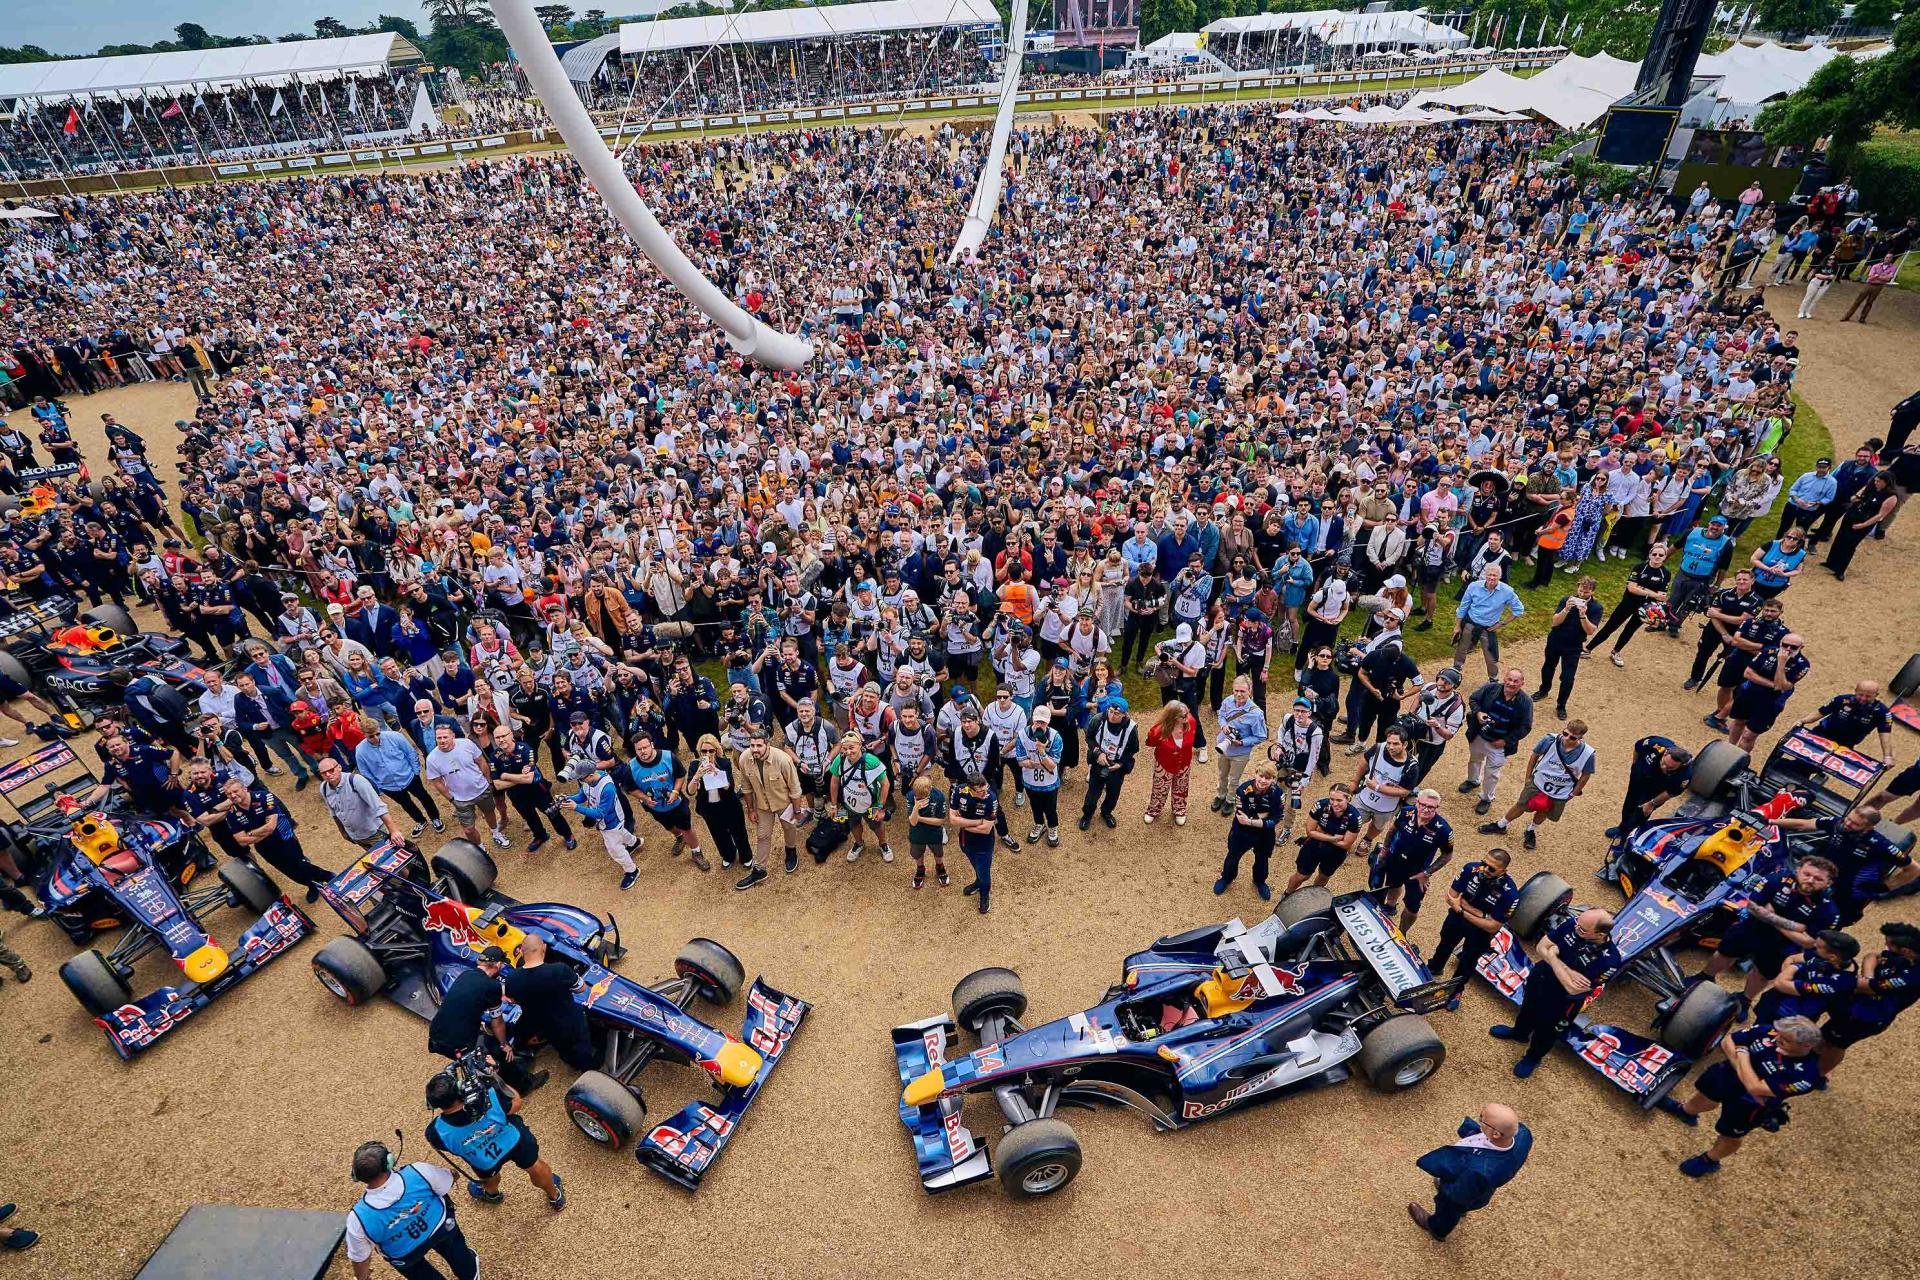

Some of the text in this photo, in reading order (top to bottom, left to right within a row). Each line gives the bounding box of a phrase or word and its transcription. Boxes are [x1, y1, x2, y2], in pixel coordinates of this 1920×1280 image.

[19, 463, 77, 477] HONDA
[46, 675, 101, 693] ORACLE
[0, 749, 75, 793] Red Bull
[1784, 736, 1874, 786] Red Bull
[1033, 769, 1045, 782] 86
[1369, 792, 1381, 803] 97
[1543, 781, 1566, 796] 67
[341, 872, 383, 904] Red
[1341, 904, 1373, 938] GIVES
[1365, 936, 1389, 964] YOU
[118, 1017, 152, 1042] Red
[971, 1043, 1005, 1074] 14
[1616, 1059, 1656, 1094] Bull
[943, 1109, 970, 1164] Bull
[484, 1142, 502, 1160] 12
[407, 1216, 429, 1240] 68
